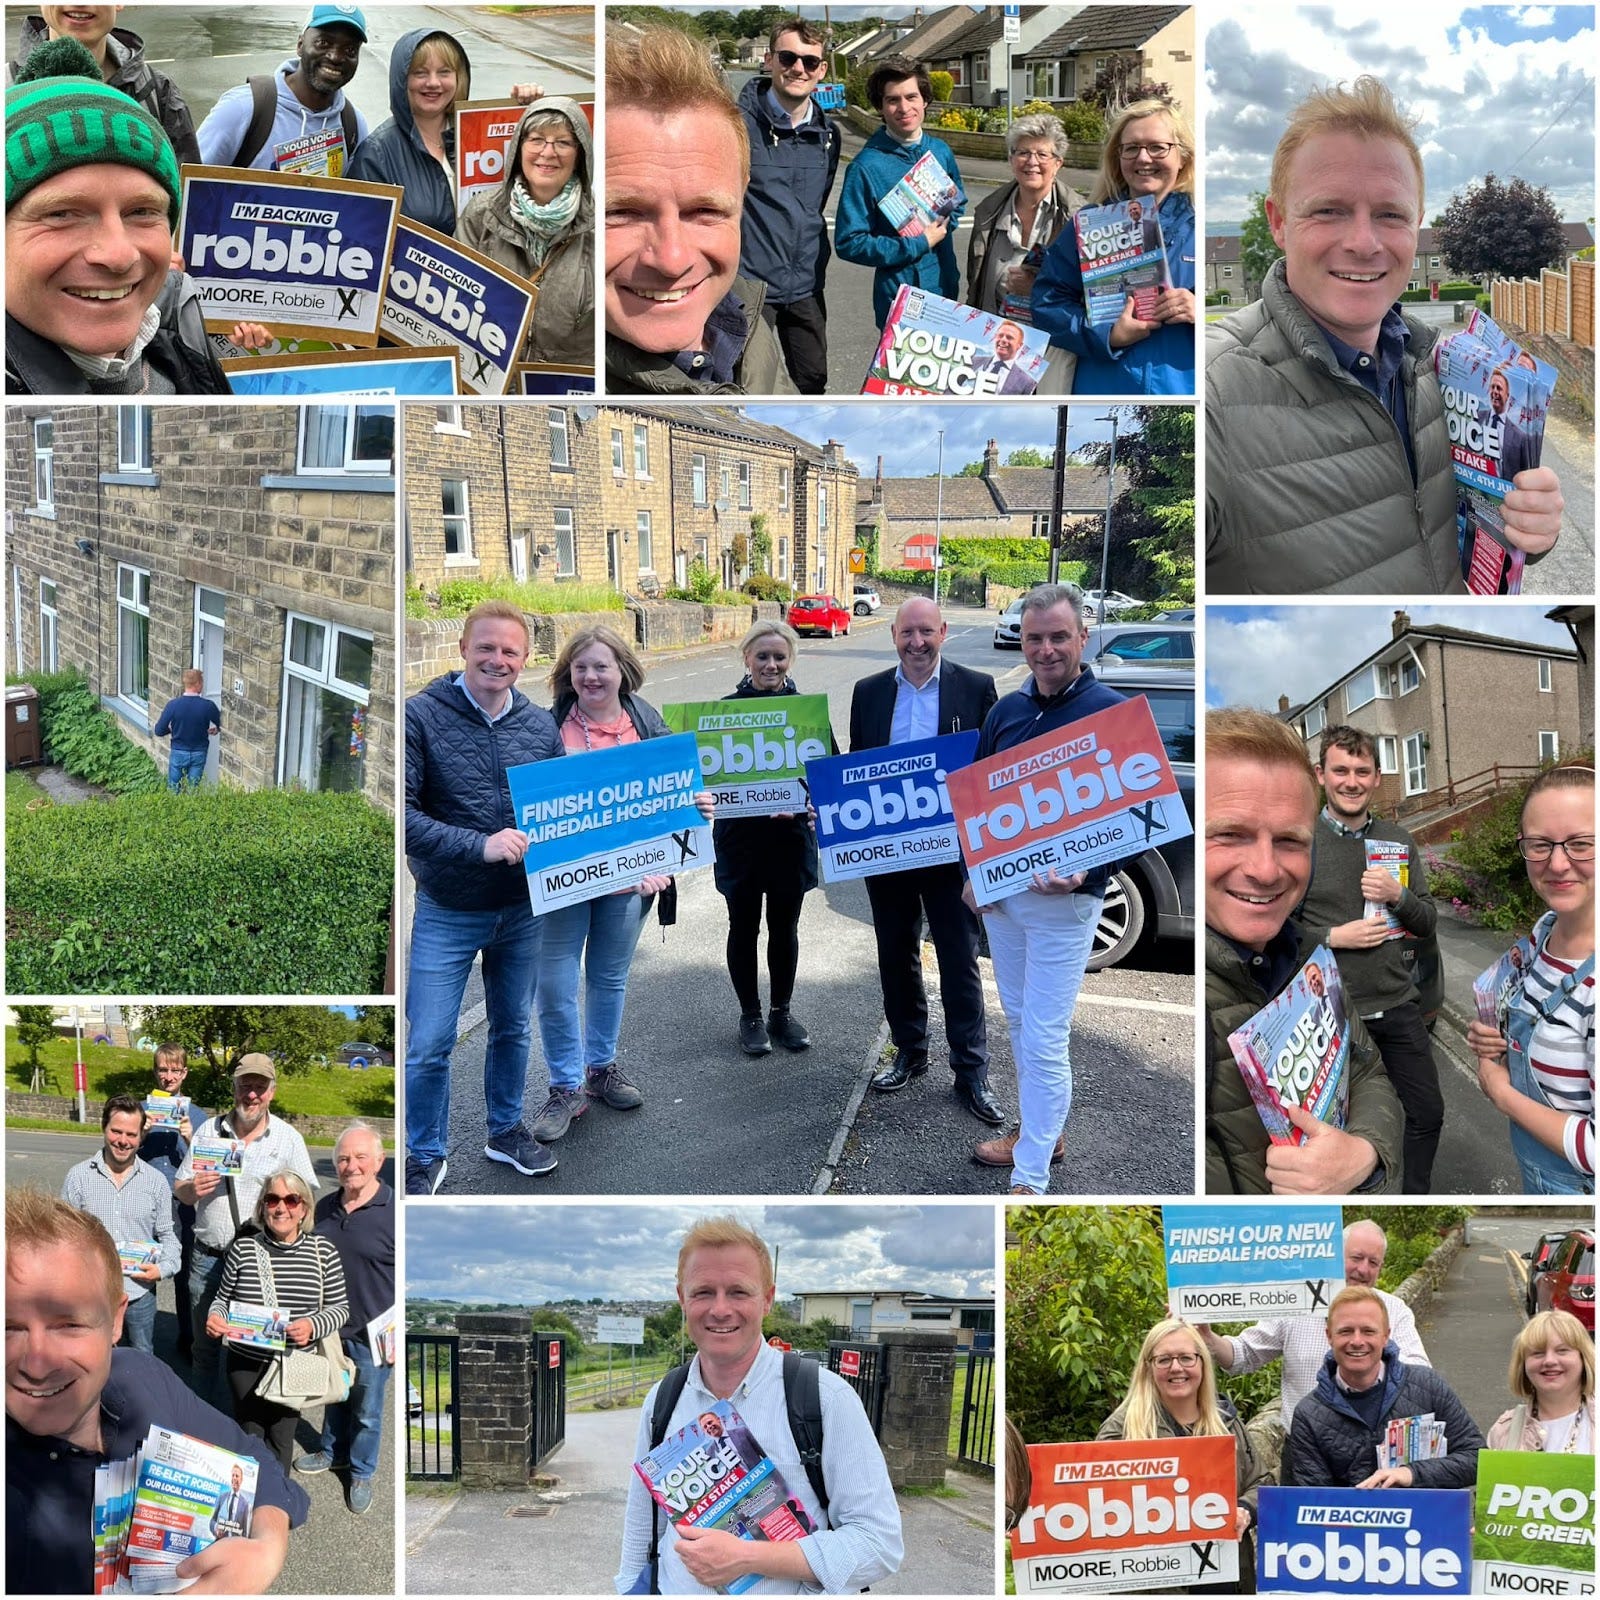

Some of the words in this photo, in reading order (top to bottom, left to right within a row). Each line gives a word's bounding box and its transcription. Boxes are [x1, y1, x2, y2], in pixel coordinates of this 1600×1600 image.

[284, 139, 309, 153] YOUR
[310, 131, 337, 145] VOICE
[490, 125, 506, 135] I'M
[235, 205, 260, 219] I'M
[262, 208, 333, 225] BACKING
[1078, 221, 1125, 244] YOUR
[190, 226, 374, 281] robbie
[1081, 229, 1144, 260] VOICE
[1090, 260, 1098, 269] IS
[1099, 256, 1111, 267] AT
[1111, 249, 1136, 264] STAKE
[408, 250, 427, 266] I'M
[428, 259, 481, 294] BACKING
[273, 290, 325, 309] Robbie
[390, 265, 507, 357] obbie
[890, 322, 977, 366] YOUR
[885, 348, 998, 395] VOICE
[1444, 410, 1501, 459] OICE
[1454, 449, 1488, 472] STAKE
[1477, 474, 1496, 490] 4TH
[701, 718, 720, 728] I'M
[723, 713, 783, 728] BACKING
[702, 727, 826, 776] obbie
[845, 768, 865, 782] I'M
[868, 756, 932, 778] BACKING
[992, 769, 1014, 787] I'M
[1018, 738, 1092, 778] BACKING
[522, 791, 594, 826] FINISH
[598, 780, 644, 807] OUR
[647, 768, 694, 796] NEW
[527, 810, 613, 846] AIREDALE
[616, 790, 697, 823] HOSPITAL
[746, 789, 791, 803] Robbie
[818, 769, 954, 836] robbi
[964, 749, 1162, 852] robbie
[546, 861, 614, 893] MOORE,
[616, 849, 665, 873] Robbie
[836, 844, 899, 866] MOORE,
[902, 835, 950, 855] Robbie
[986, 846, 1061, 885] MOORE,
[1063, 826, 1124, 857] Robbie
[1266, 1010, 1317, 1094] YOUR
[1280, 1007, 1338, 1109] VOICE
[1306, 1087, 1320, 1111] AT
[1316, 1044, 1338, 1090] STAKE
[1313, 1071, 1338, 1119] URSDAY,
[1169, 1226, 1234, 1247] FINISH
[1238, 1225, 1284, 1244] OUR
[1287, 1222, 1336, 1241] NEW
[1169, 1246, 1251, 1265] AIREDALE
[1253, 1242, 1336, 1261] HOSPITAL
[1184, 1292, 1246, 1308] MOORE,
[1250, 1290, 1297, 1305] Robbie
[145, 1478, 162, 1489] OUR
[162, 1483, 183, 1495] LOCAL
[183, 1488, 217, 1504] CHAMPION
[148, 1464, 191, 1485] RE-ELECT
[191, 1476, 221, 1493] ROBBIE
[652, 1447, 710, 1498] YOUR
[664, 1447, 743, 1513] VOICE
[1058, 1464, 1087, 1481] I'M
[1090, 1460, 1174, 1478] BACKING
[685, 1511, 697, 1523] IS
[695, 1499, 711, 1515] AT
[709, 1474, 740, 1502] STAKE
[697, 1491, 738, 1528] THURSDAY,
[735, 1480, 751, 1497] 4TH
[749, 1464, 768, 1483] JULY
[1018, 1477, 1230, 1544] robbie
[1301, 1508, 1326, 1522] I'M
[1328, 1509, 1407, 1524] BACKING
[1484, 1523, 1518, 1537] our
[1035, 1561, 1117, 1582] MOORE,
[1121, 1556, 1181, 1574] Robbie
[1264, 1530, 1462, 1587] robbie
